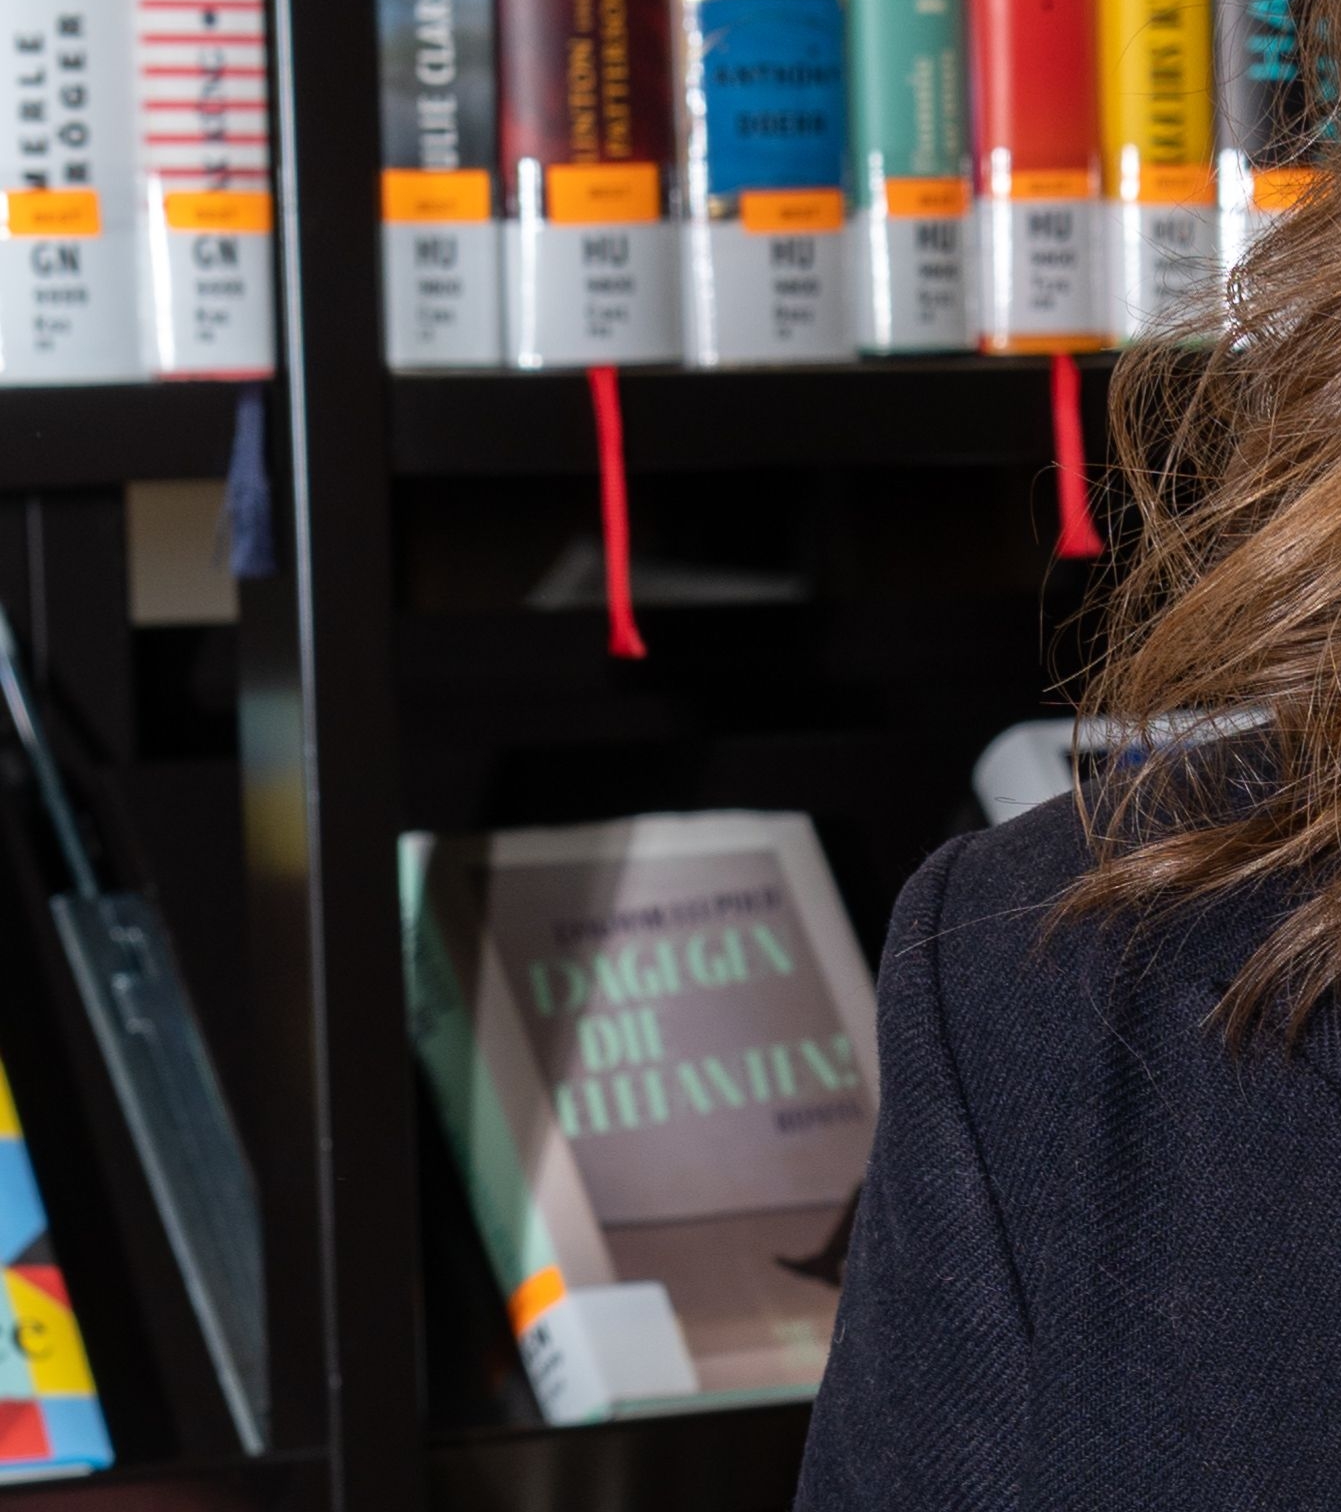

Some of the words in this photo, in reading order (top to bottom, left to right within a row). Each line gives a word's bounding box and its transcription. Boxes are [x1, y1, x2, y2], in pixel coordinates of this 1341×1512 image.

[60, 12, 89, 186] RÖGER
[420, 90, 457, 170] ULIE
[572, 36, 599, 166] LINTON
[1147, 39, 1187, 166] SHUFF
[529, 924, 794, 1018] DAGEGEN
